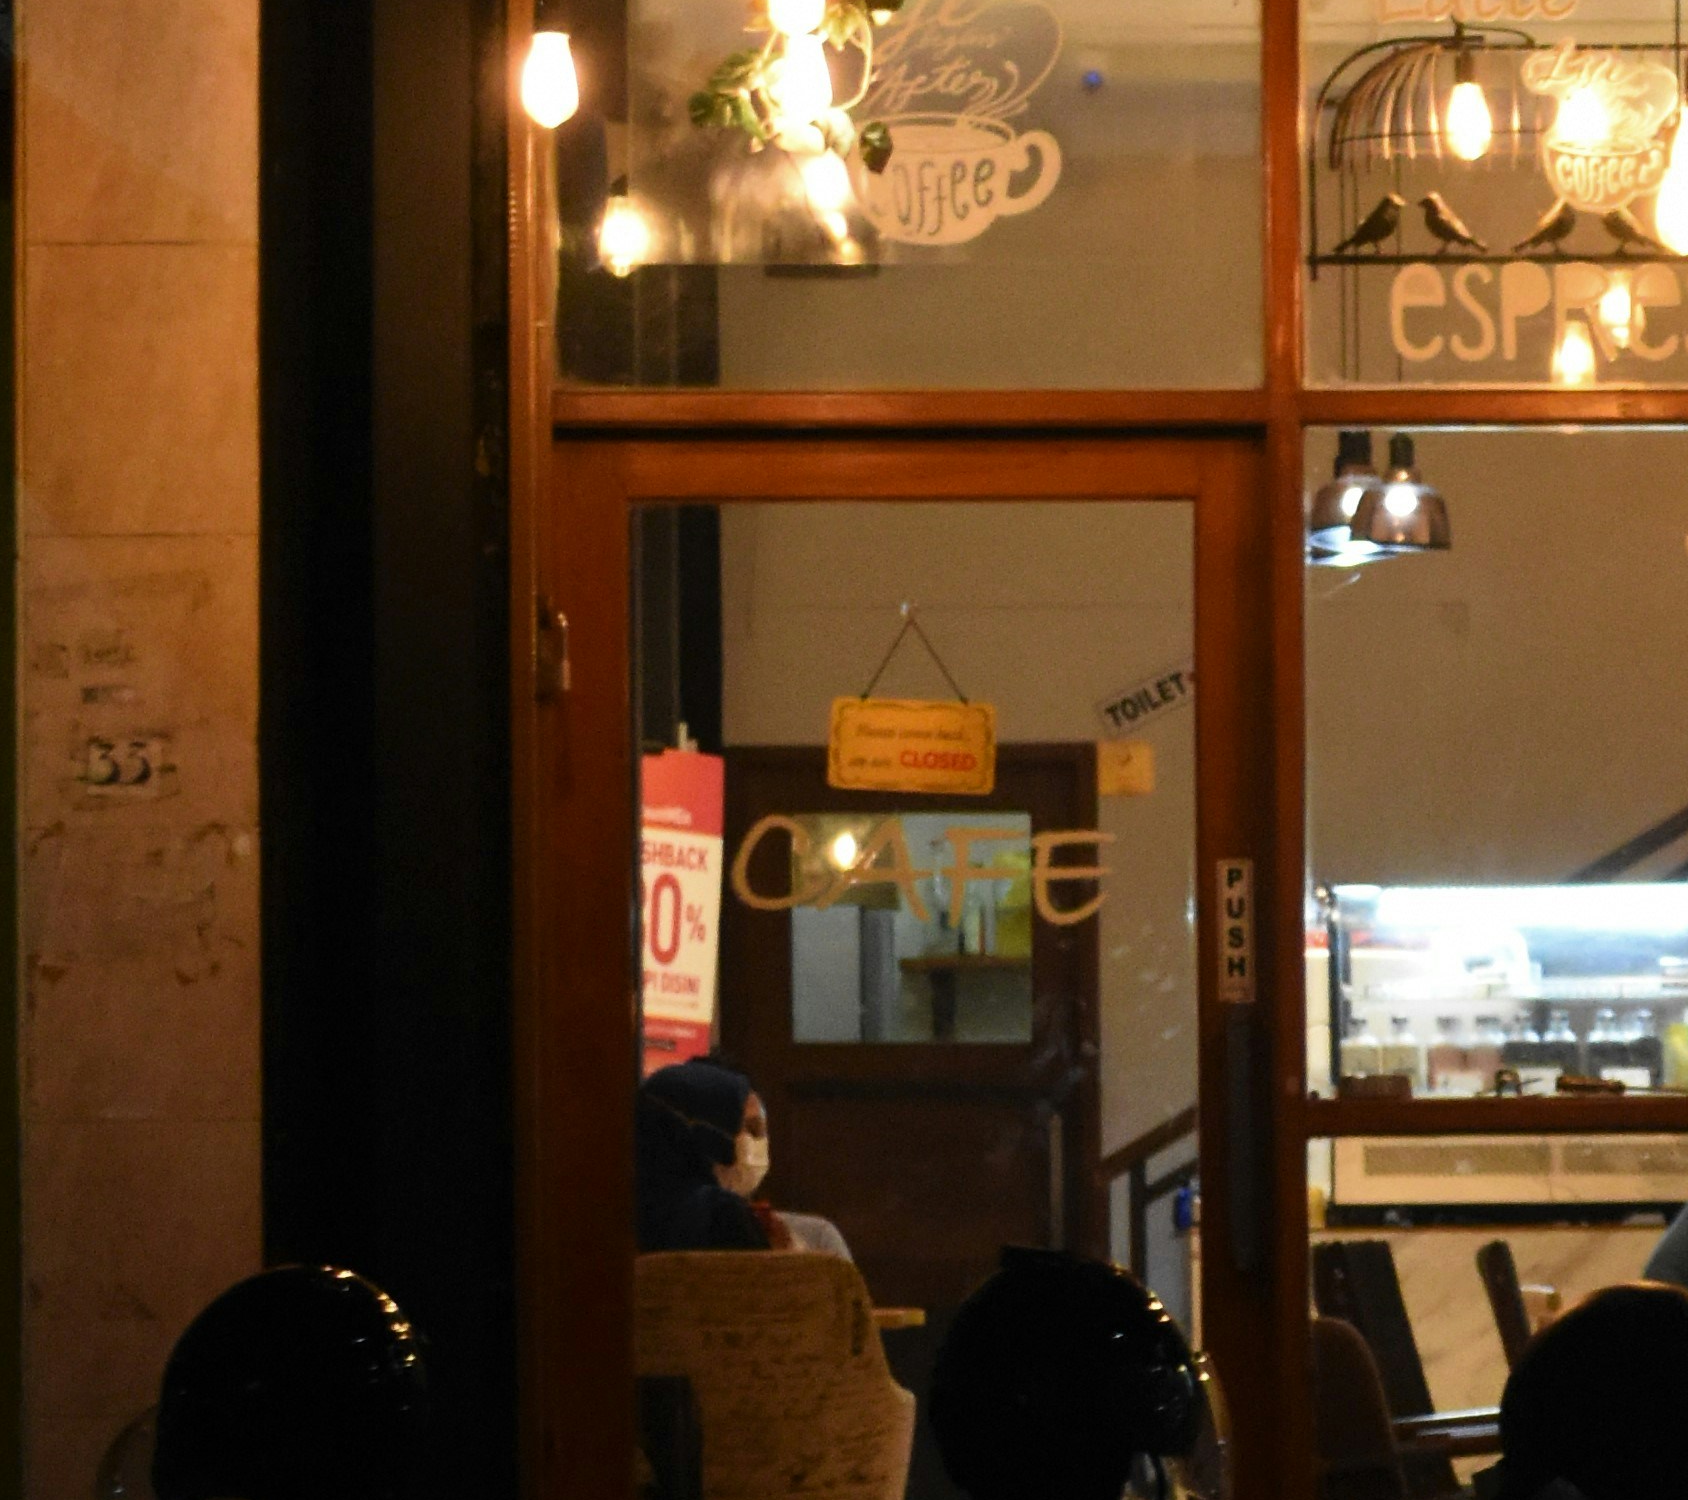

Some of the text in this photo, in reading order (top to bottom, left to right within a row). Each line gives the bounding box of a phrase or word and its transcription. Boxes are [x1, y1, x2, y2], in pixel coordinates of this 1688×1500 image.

[868, 157, 997, 237] offee
[1104, 671, 1187, 729] TOILET
[900, 750, 978, 773] CLOSED
[730, 811, 1117, 928] CAFE
[1225, 867, 1248, 978] PUSH
